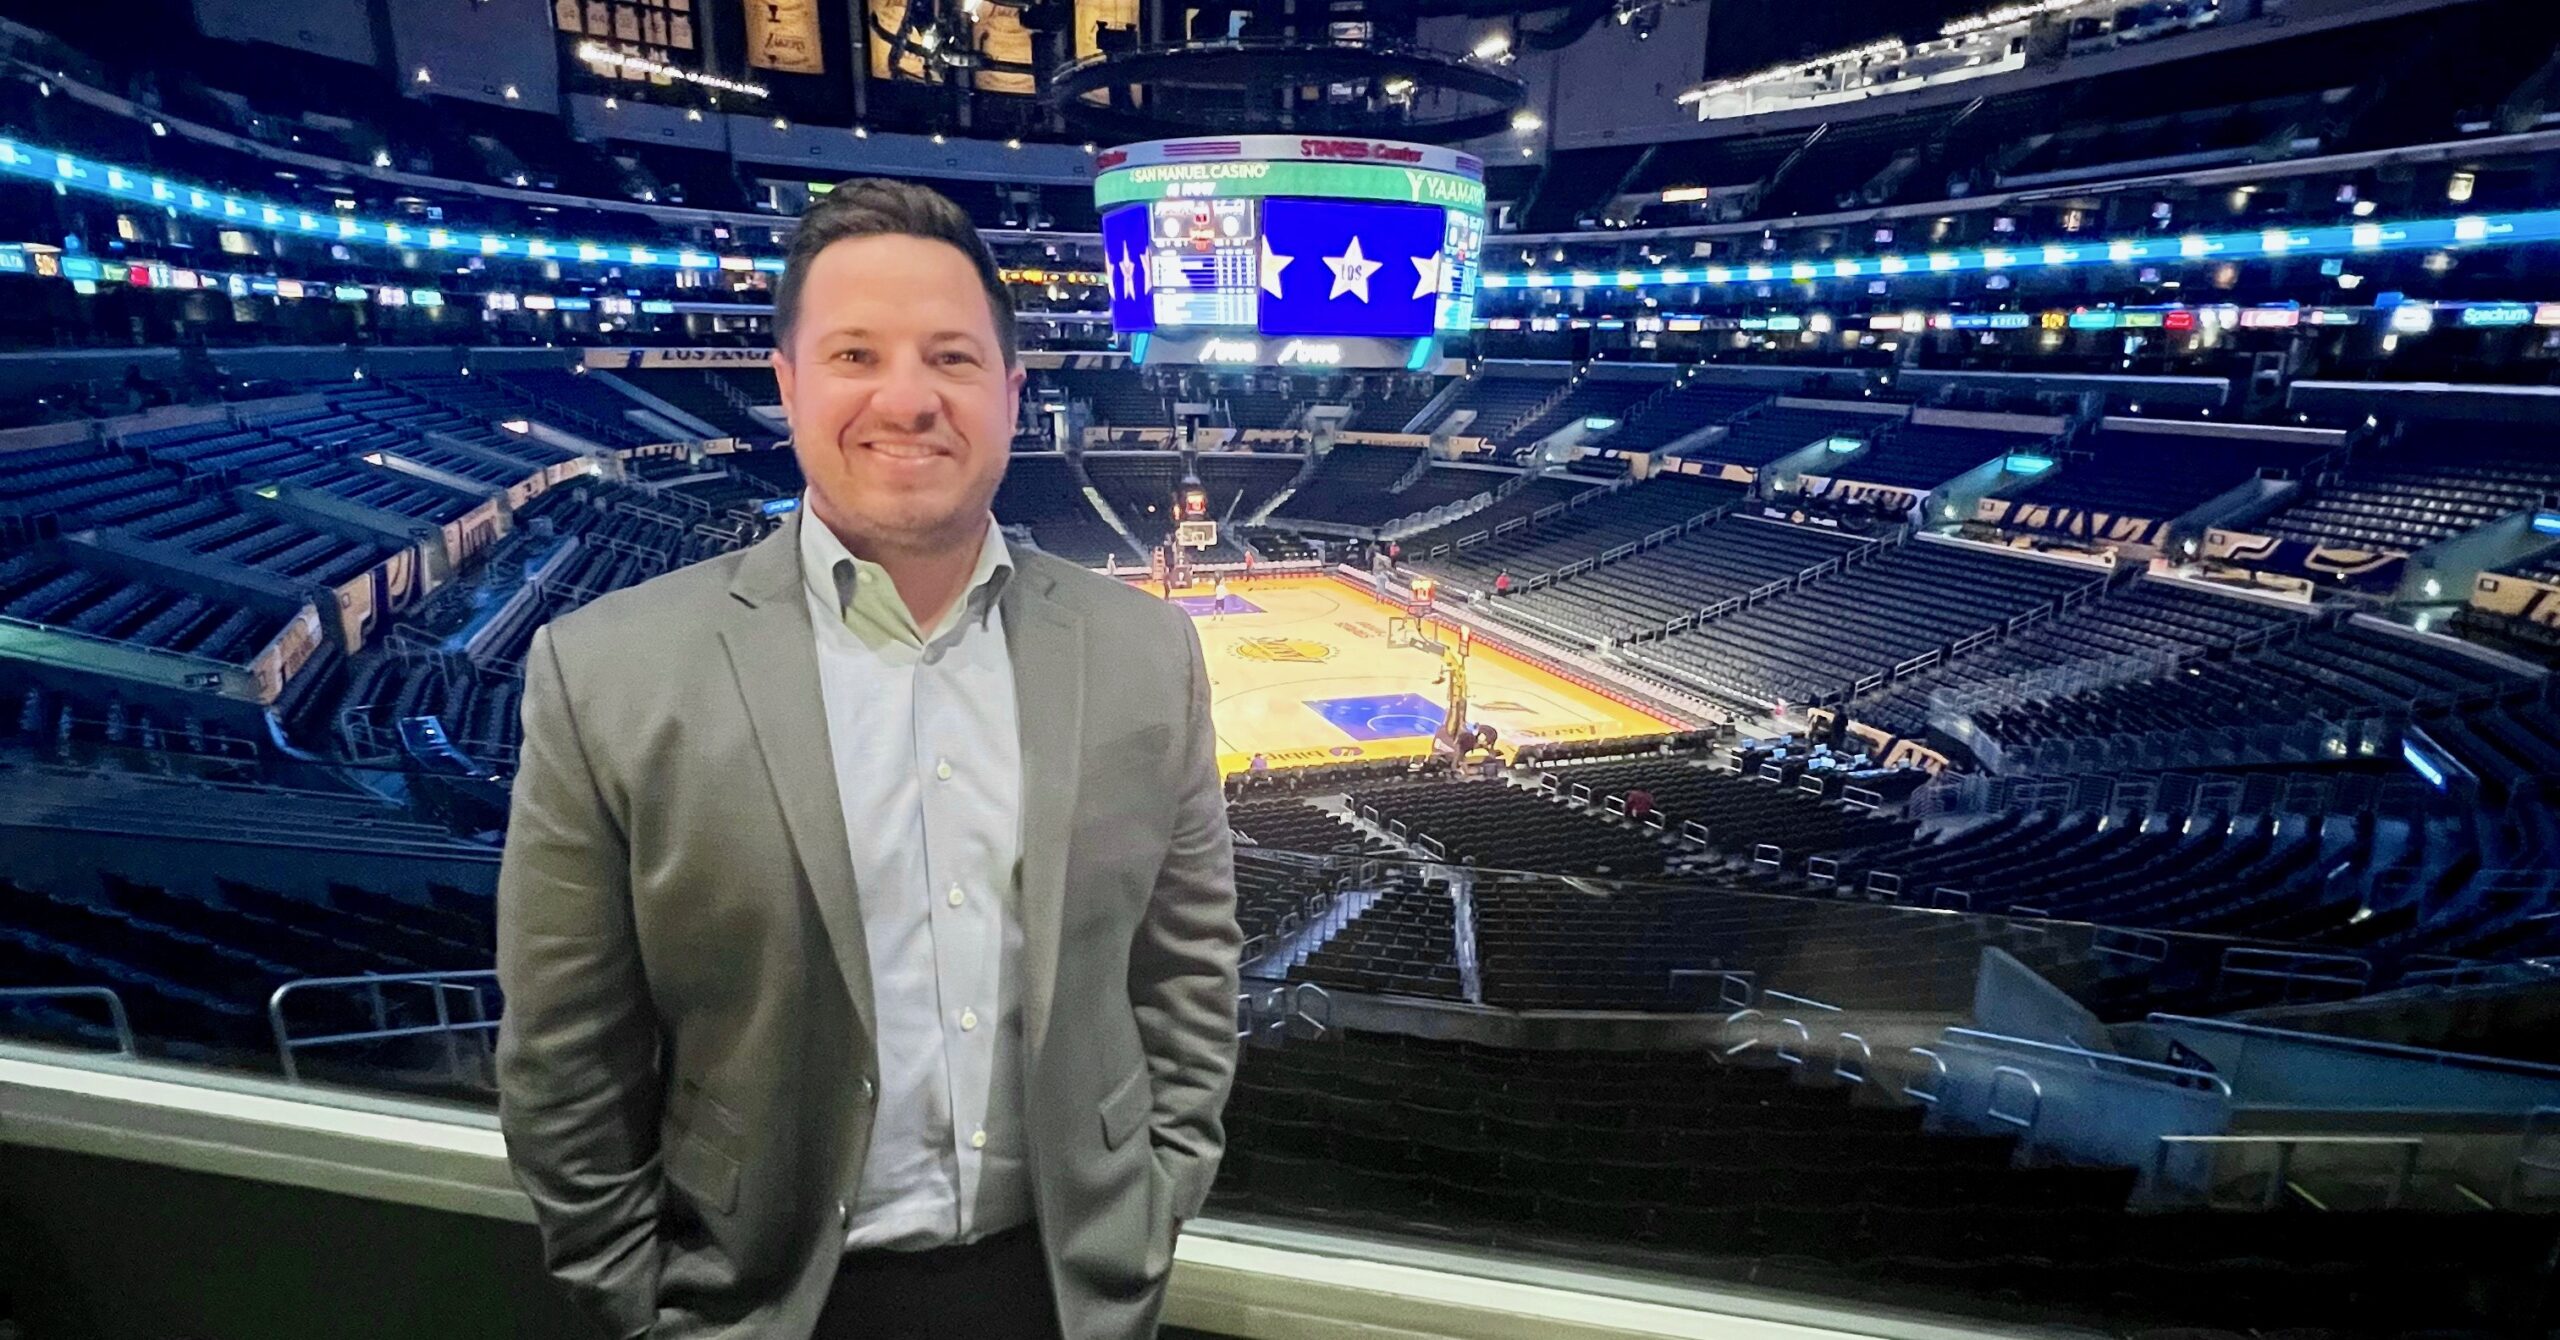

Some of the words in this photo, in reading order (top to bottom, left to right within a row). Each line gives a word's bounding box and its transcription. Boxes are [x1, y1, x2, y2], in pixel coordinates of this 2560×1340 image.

[1134, 168, 1157, 183] SAN
[1158, 165, 1210, 181] MANUEL
[2463, 307, 2532, 326] Spectrum
